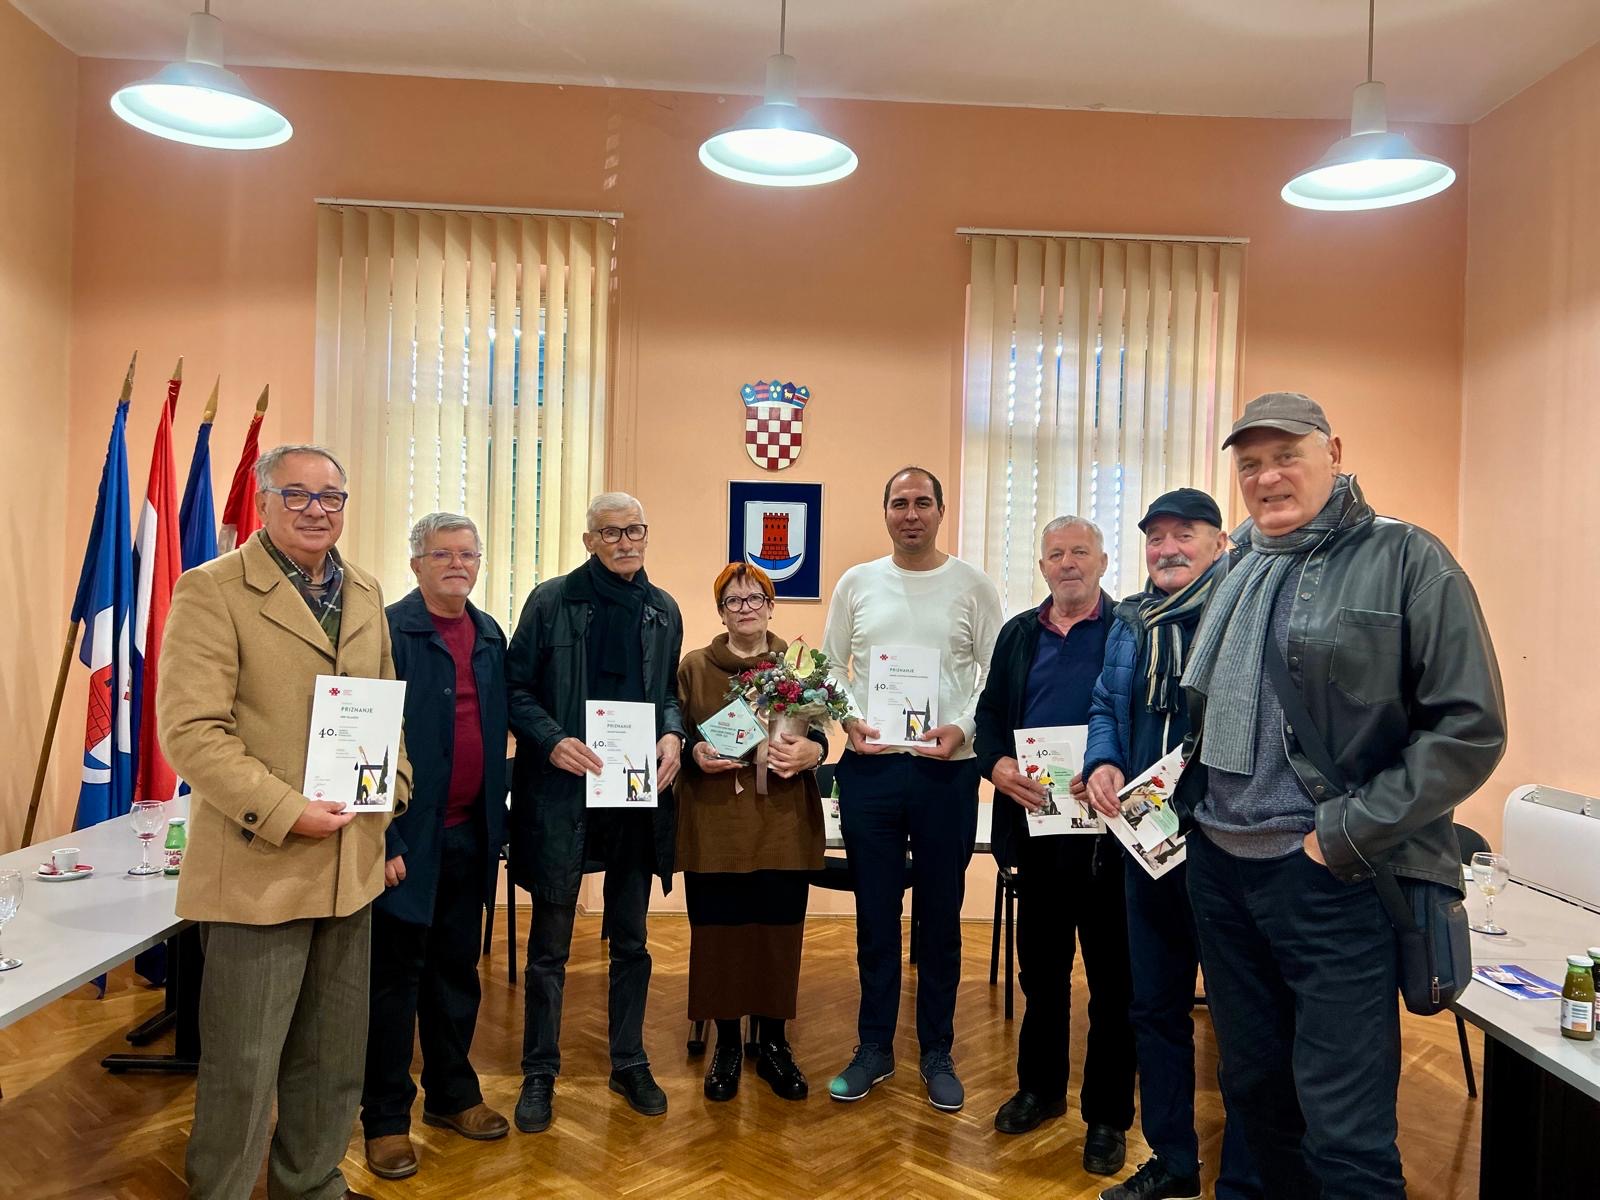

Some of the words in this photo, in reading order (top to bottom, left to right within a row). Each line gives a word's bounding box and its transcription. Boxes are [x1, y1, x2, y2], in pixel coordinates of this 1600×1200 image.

[874, 683, 889, 691] 40.
[318, 728, 338, 738] 40.
[592, 740, 607, 749] 40.
